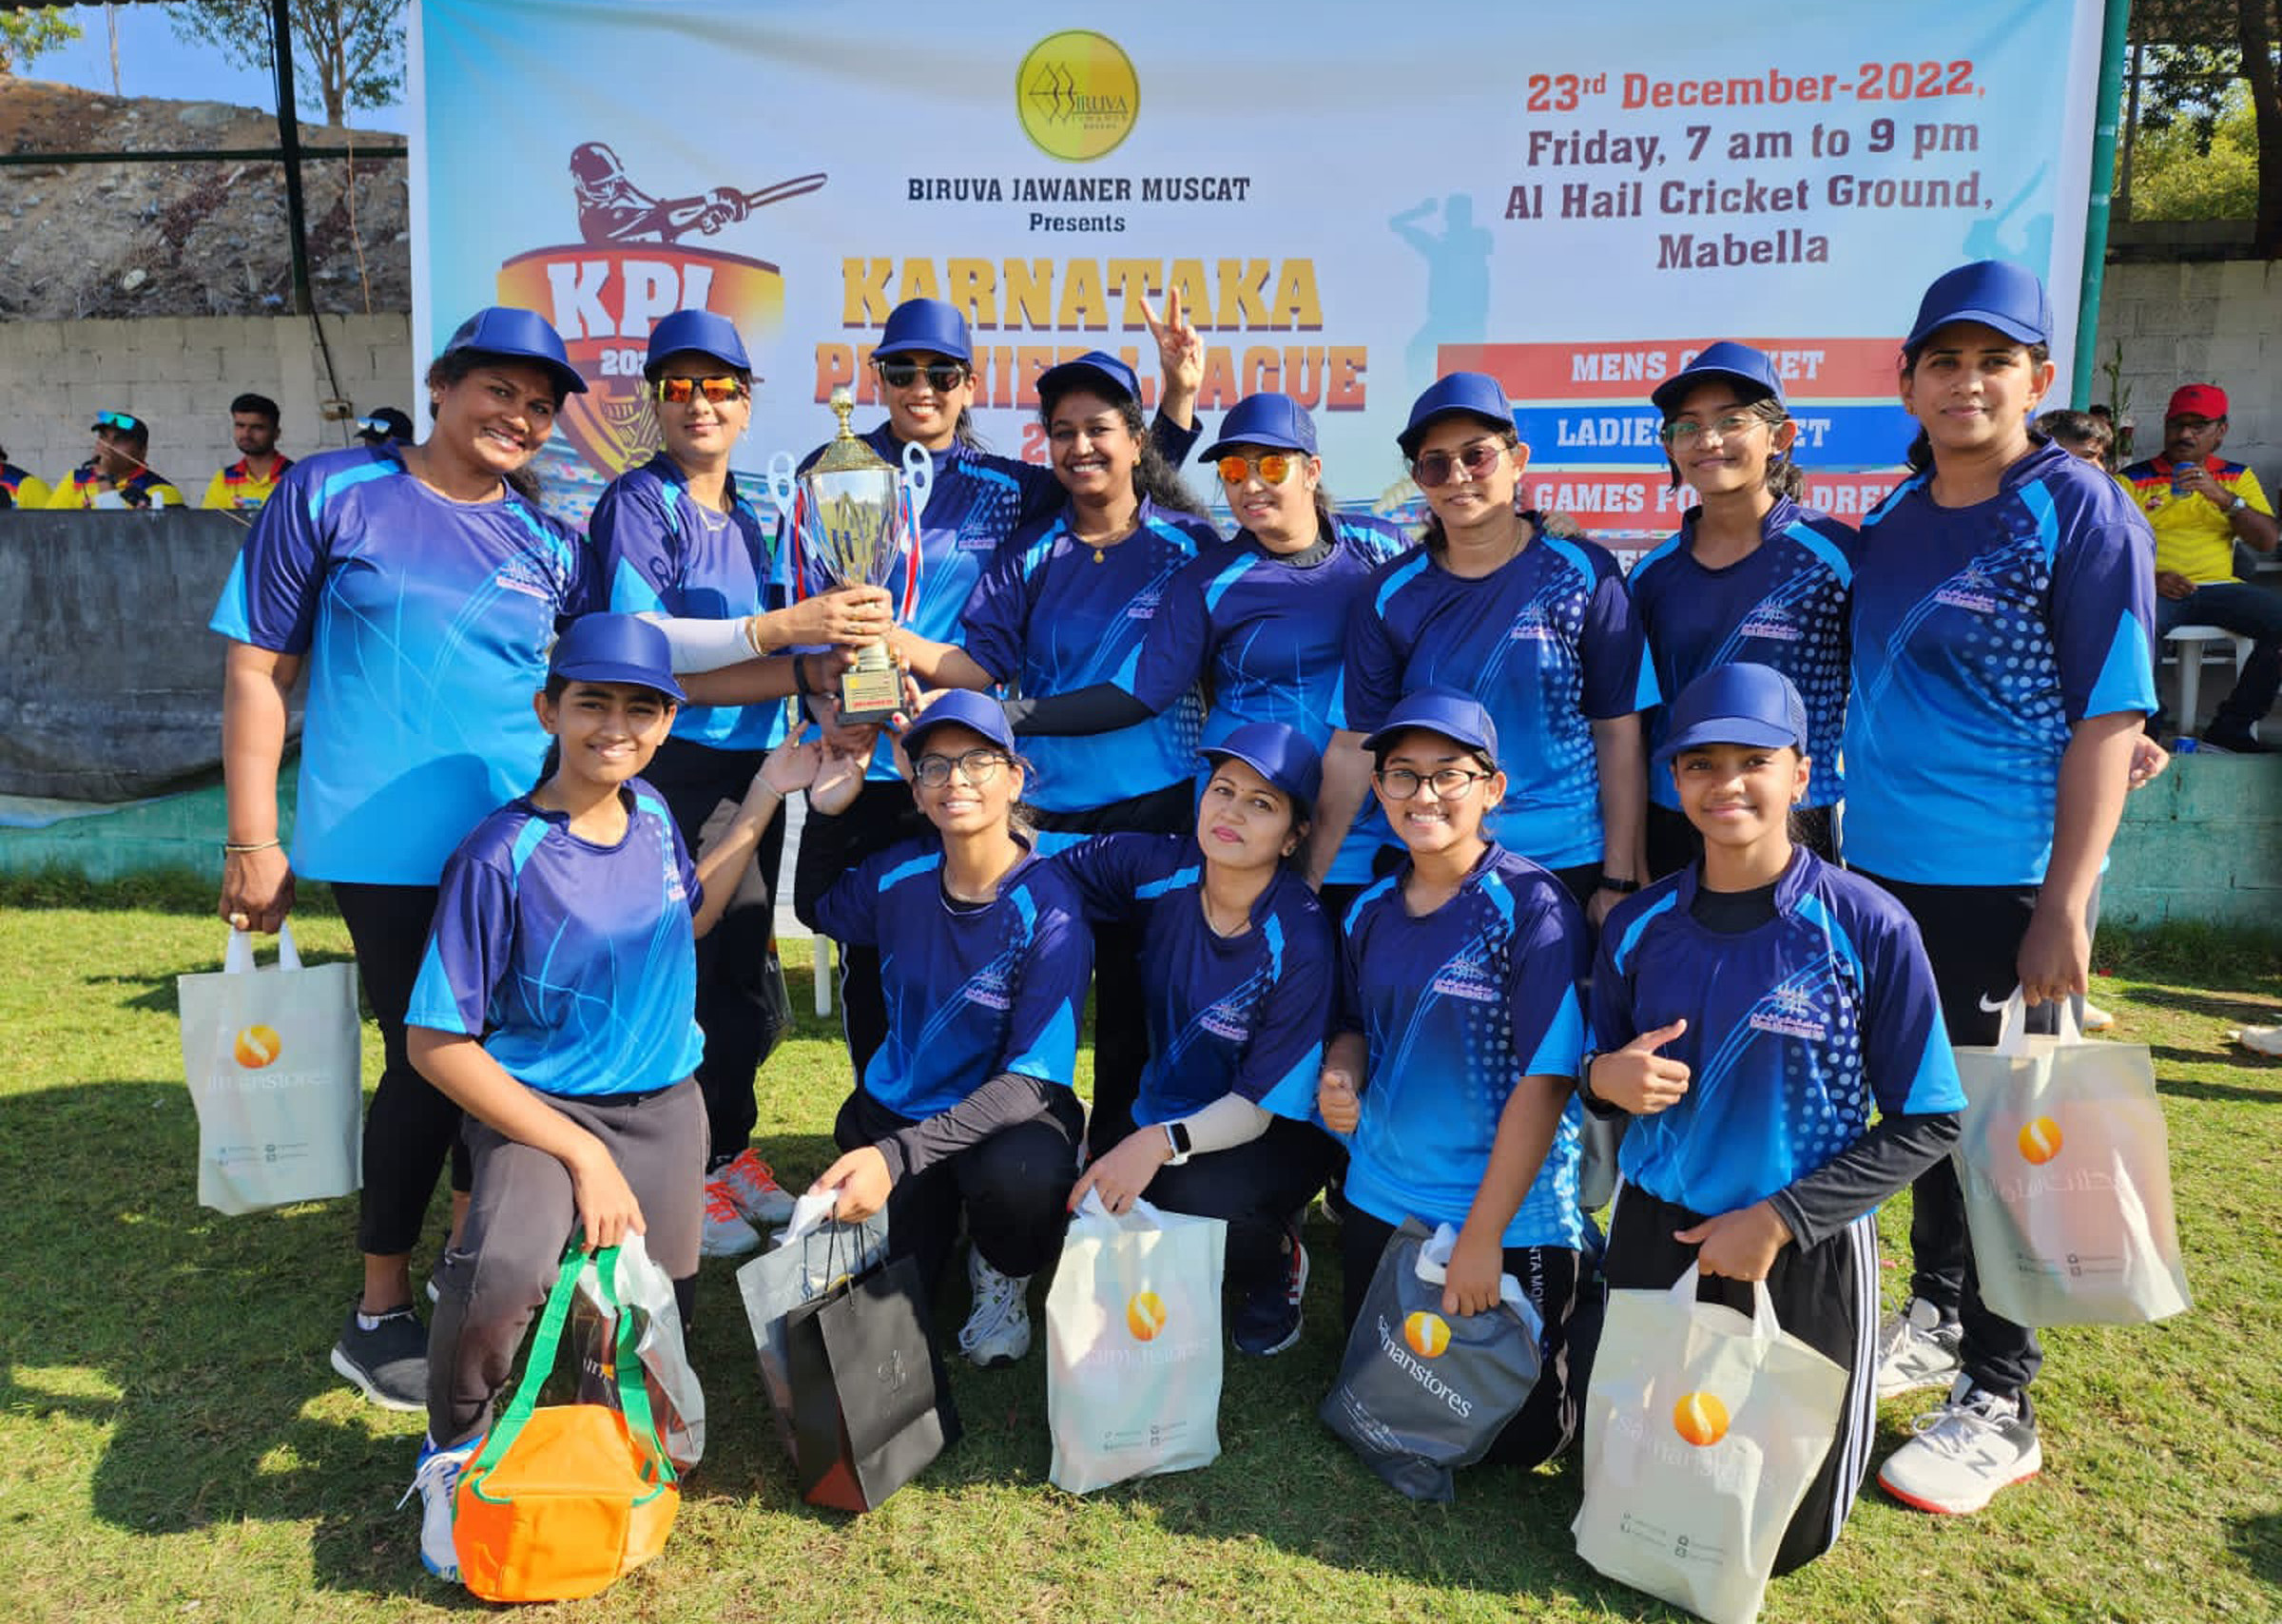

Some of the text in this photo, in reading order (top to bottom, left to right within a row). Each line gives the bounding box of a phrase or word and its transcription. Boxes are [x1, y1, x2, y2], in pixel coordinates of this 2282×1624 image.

[1527, 72, 1606, 111] 23rd
[1527, 118, 1979, 171] Friday, 7 am to 9 pm
[908, 177, 1250, 202] BIRUVA JAWANER MUSCAT
[1505, 171, 1994, 220] Al Hail Cricket Ground,
[1029, 212, 1126, 232] Presents
[1656, 229, 1828, 269] Mabella
[1119, 345, 1367, 412] LAGUE
[1571, 350, 1667, 381] MENS
[1534, 483, 1700, 512] GAMES FO
